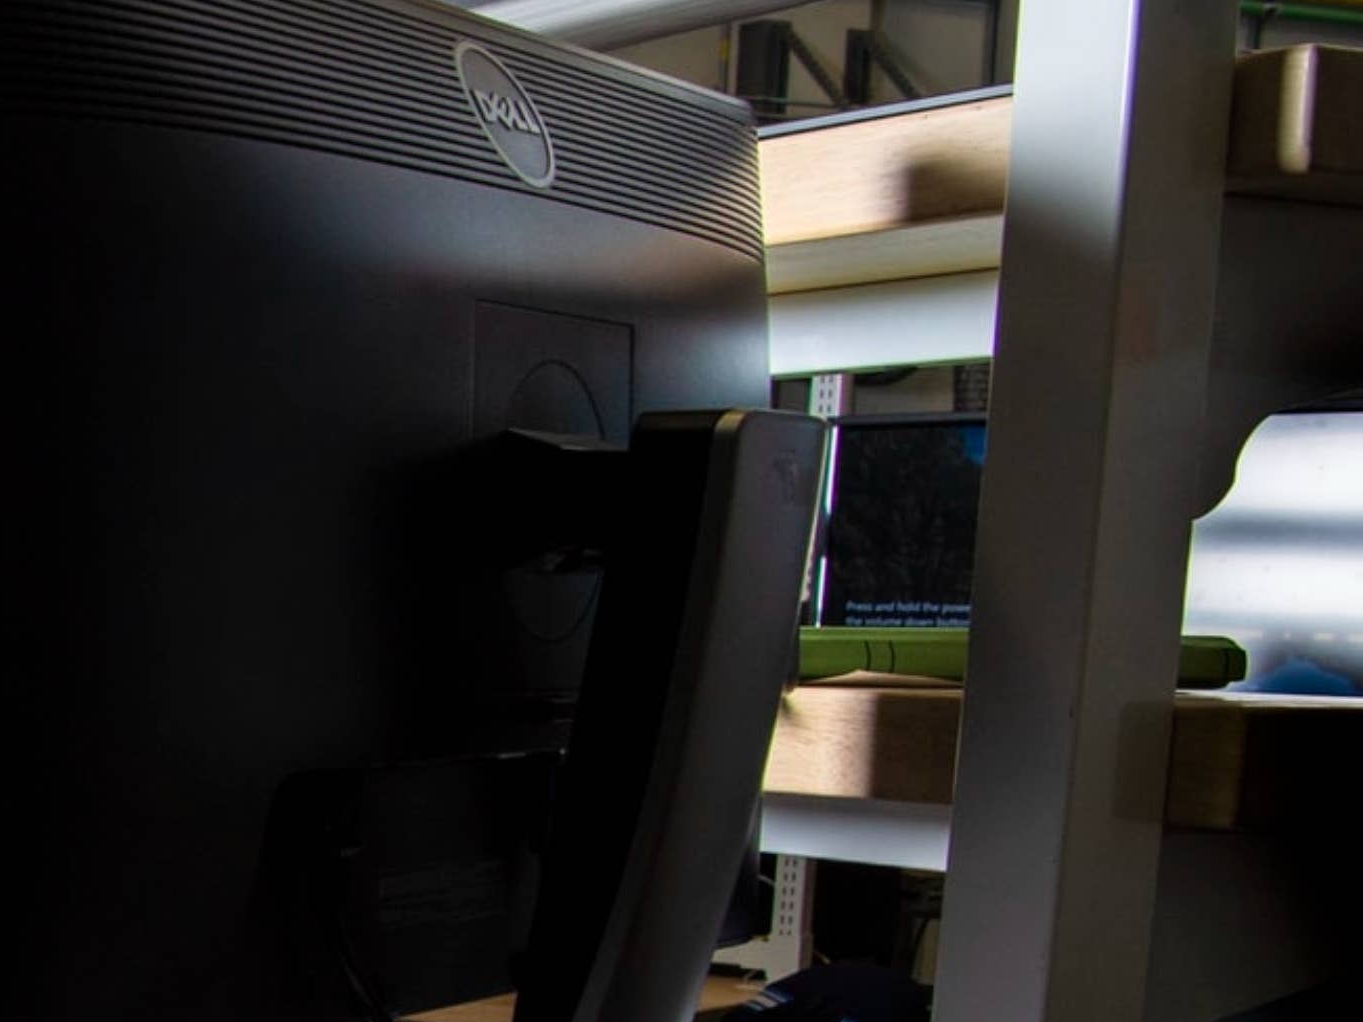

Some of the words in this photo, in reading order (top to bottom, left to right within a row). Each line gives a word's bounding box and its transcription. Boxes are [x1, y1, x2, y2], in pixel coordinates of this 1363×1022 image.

[471, 86, 542, 134] DELL
[846, 601, 872, 612] Press
[875, 601, 895, 612] and
[896, 601, 920, 612] hold
